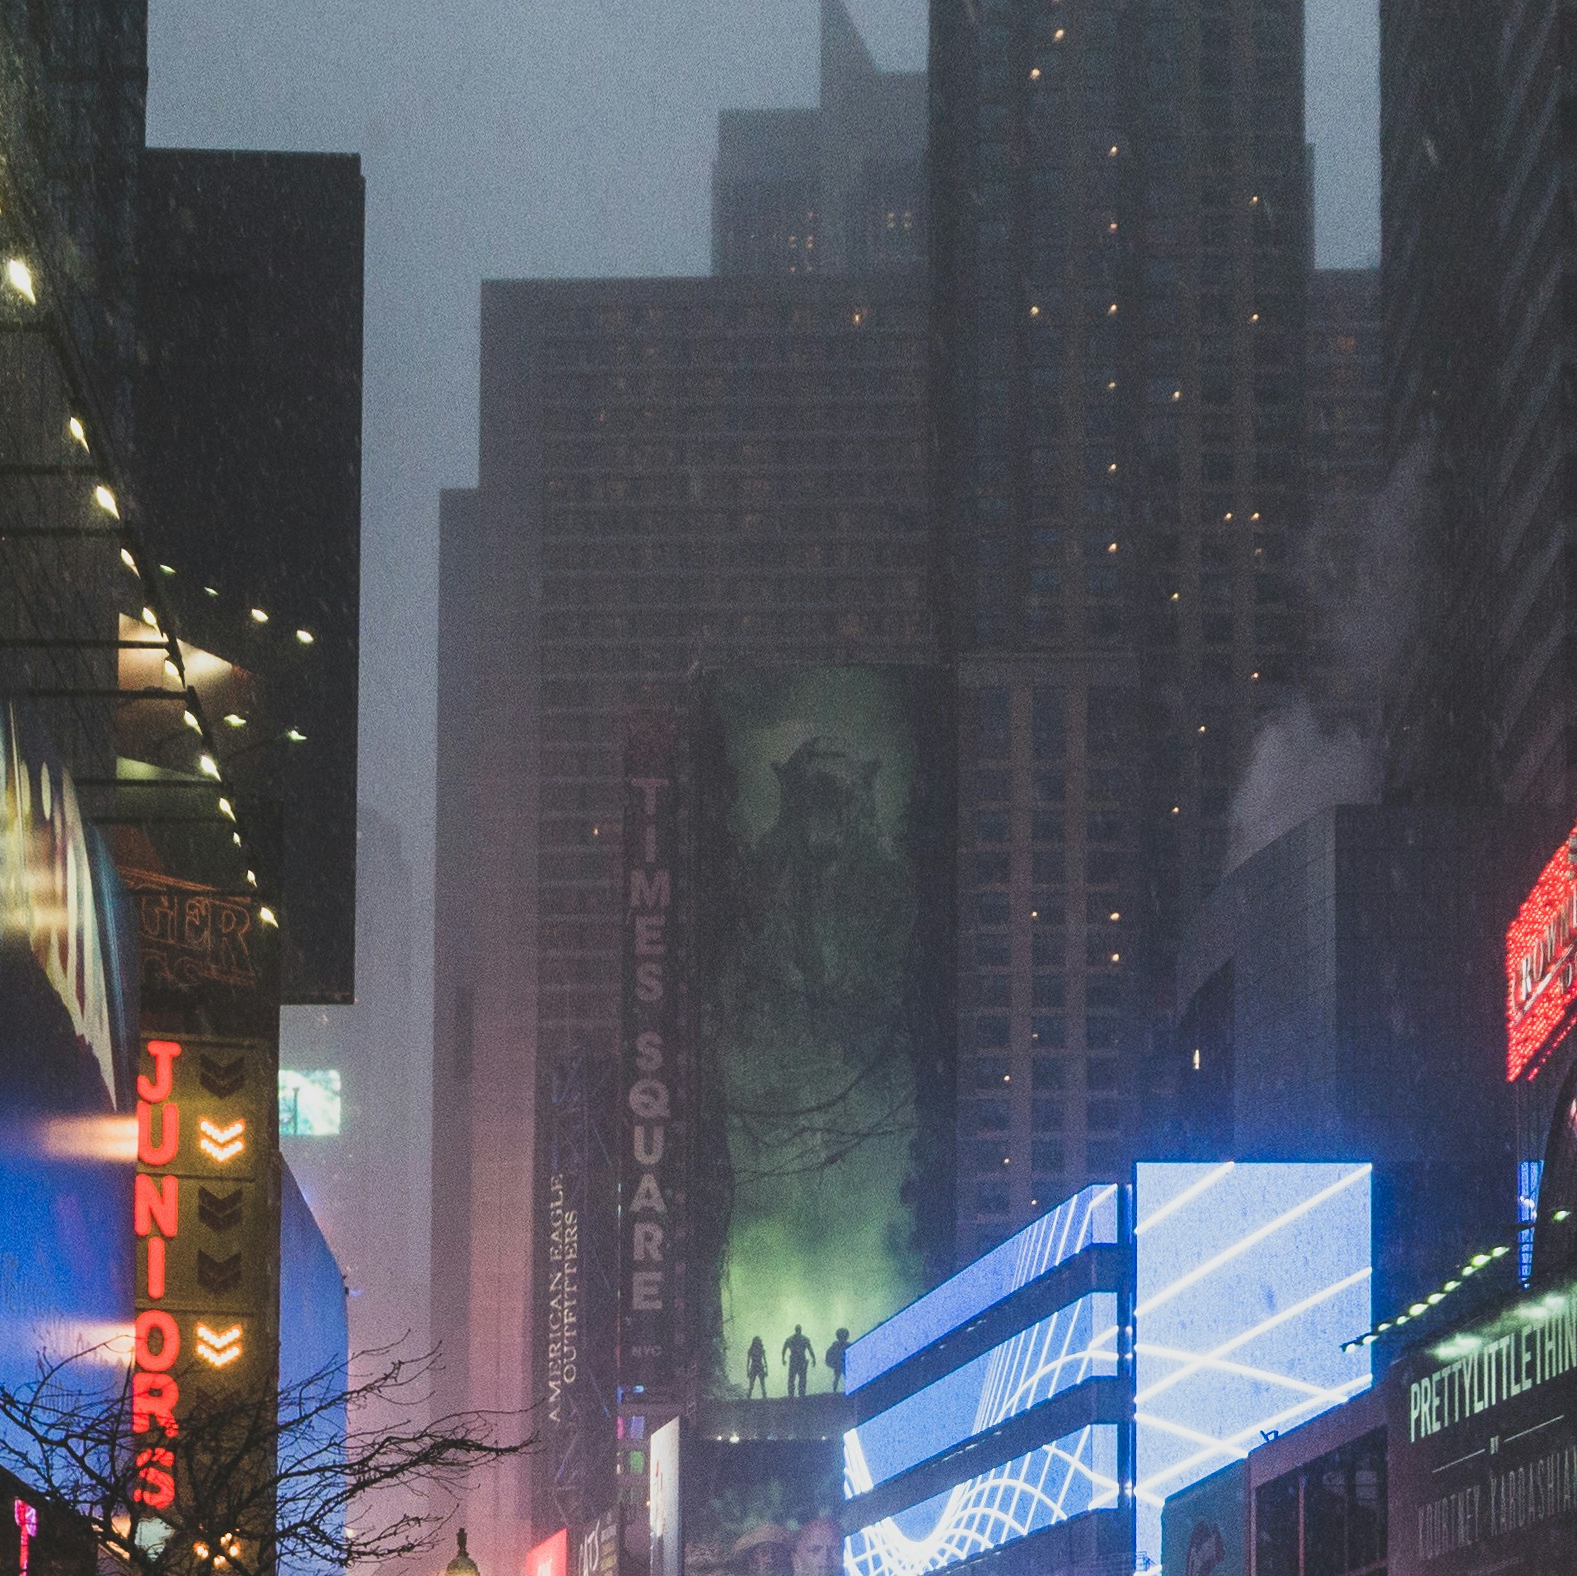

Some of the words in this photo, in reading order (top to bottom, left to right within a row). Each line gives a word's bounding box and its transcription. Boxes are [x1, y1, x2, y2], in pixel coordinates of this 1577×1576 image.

[631, 777, 670, 1000] TIMES
[550, 1173, 564, 1261] EAGLE
[628, 1032, 670, 1311] SQUARE
[548, 1272, 563, 1423] AMERICAN
[563, 1210, 578, 1384] OUTFITTERS
